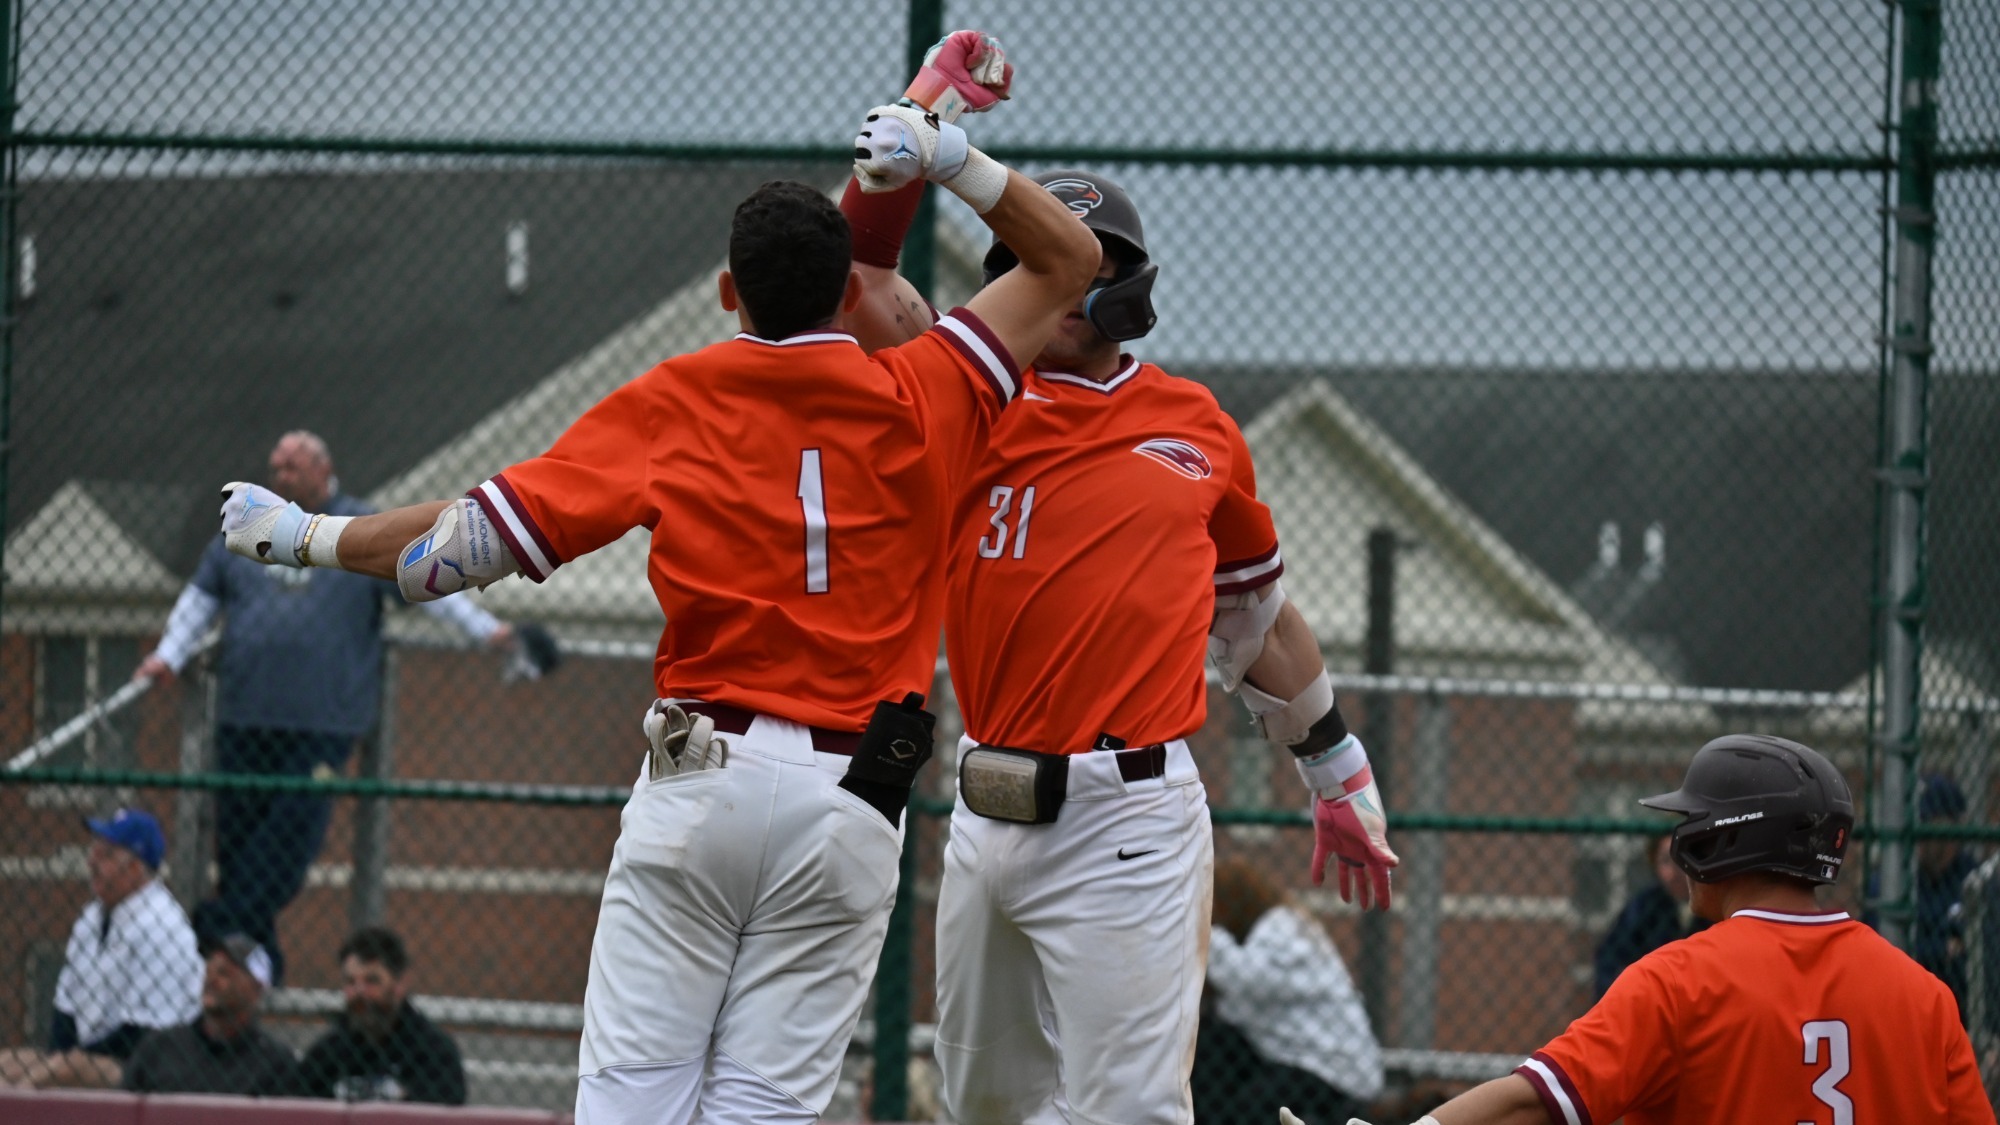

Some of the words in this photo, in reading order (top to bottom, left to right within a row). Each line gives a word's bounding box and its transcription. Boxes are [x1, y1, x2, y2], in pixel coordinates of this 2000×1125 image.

[467, 510, 475, 535] autism
[795, 447, 830, 594] 1
[978, 485, 1036, 559] 31
[469, 536, 479, 566] speaks
[478, 517, 491, 566] MOMENT
[1101, 737, 1110, 749] L
[1714, 811, 1764, 827] RAWLINGS
[1796, 1019, 1855, 1125] 3
